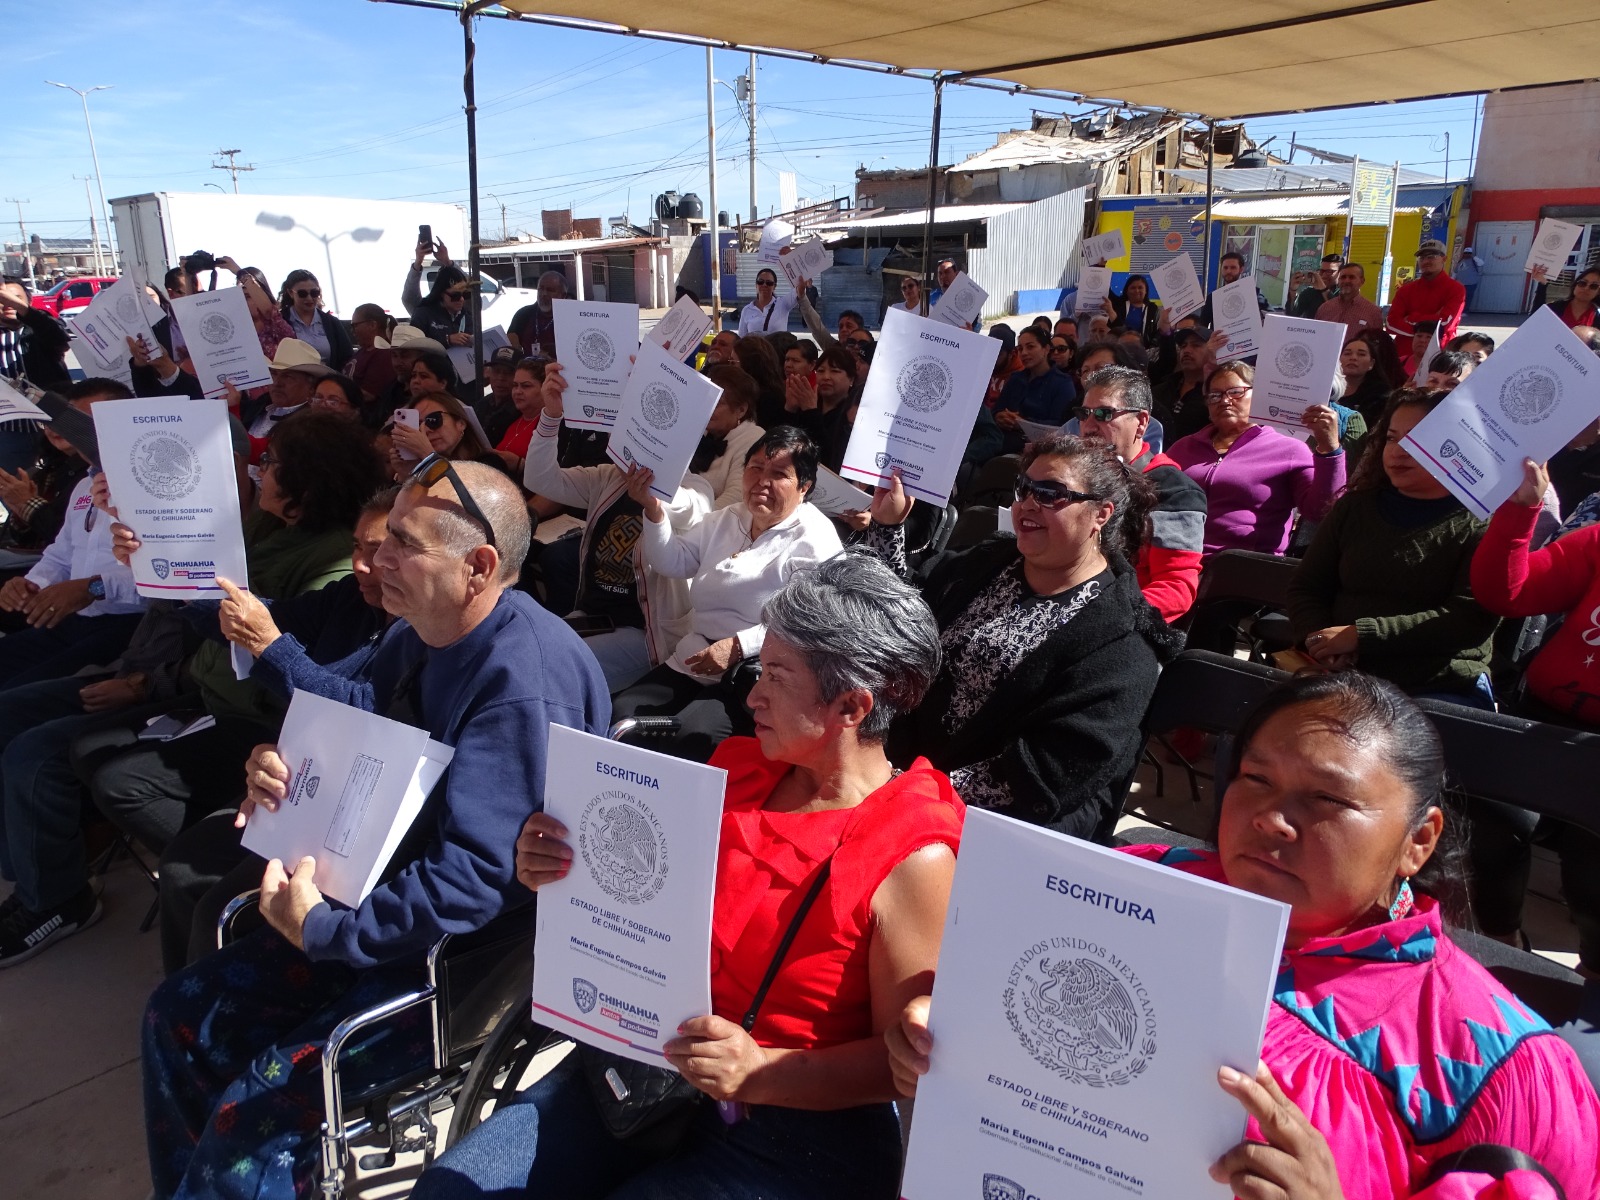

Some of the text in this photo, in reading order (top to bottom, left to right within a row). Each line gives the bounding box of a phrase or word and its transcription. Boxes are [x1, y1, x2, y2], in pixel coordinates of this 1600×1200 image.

[920, 331, 960, 349] ESCRITURA
[1286, 326, 1316, 334] ESCRITURA
[660, 362, 688, 387] ESCRITURA
[1554, 343, 1589, 377] ESCRITURA
[133, 415, 183, 424] ESCRITURA
[130, 430, 200, 465] ESTADOS UNIDOS MEXICANOS
[891, 457, 924, 472] CHIHUAHUA
[1456, 451, 1485, 479] CHIHUAHUA
[596, 761, 660, 790] ESCRITURA
[579, 790, 669, 861] ESTADOS UNIDOS MEXICANOS
[1045, 874, 1156, 925] ESCRITURA
[570, 896, 671, 943] ESTADO LIBRE Y SOBERANO
[591, 916, 646, 944] DE CHIHUAHUA
[570, 936, 667, 981] María Eugenia Campos Galván
[1008, 936, 1157, 1038] ESTADOS UNIDOS MEXICANOS
[599, 992, 660, 1023] CHIHUAHUA
[601, 1008, 620, 1021] Juntos
[627, 1023, 657, 1037] podemos
[987, 1074, 1149, 1143] ESTADO LIBRE Y SOBERANO
[1021, 1098, 1108, 1139] DE CHIHUAHUA
[978, 1126, 1143, 1196] Gobernadora Constitucional del Estado de Chihuahua
[980, 1116, 1144, 1188] María Eugenia Campos Galván
